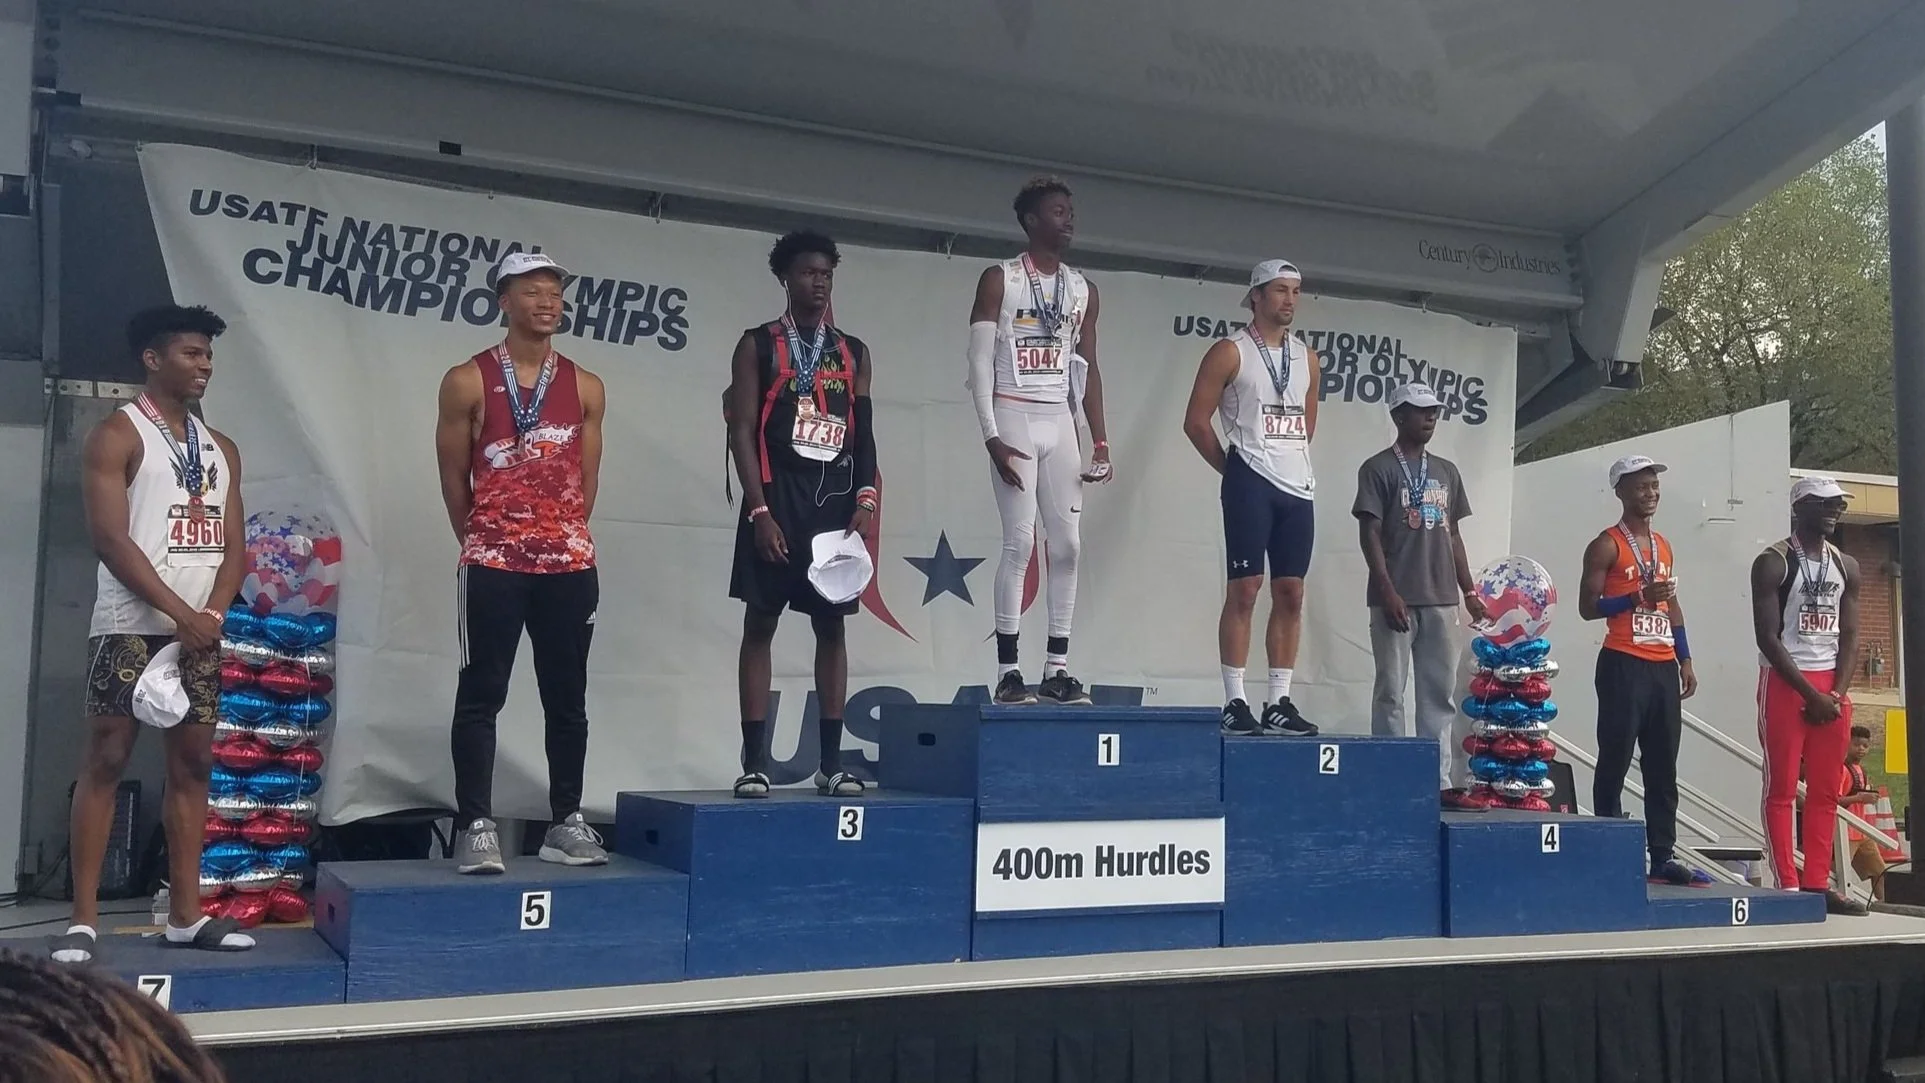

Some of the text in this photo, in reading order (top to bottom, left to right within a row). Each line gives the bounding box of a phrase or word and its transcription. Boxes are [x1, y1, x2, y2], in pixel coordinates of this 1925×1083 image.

[189, 189, 542, 264] USATF NATIONA
[1418, 239, 1561, 275] Century Industries
[286, 231, 688, 317] JUNIOR MPIC
[243, 248, 690, 352] CHAMPIOHIPS
[1173, 316, 1407, 359] USAT ATIONAL
[1017, 348, 1061, 369] 5047
[538, 432, 564, 442] BLAZE
[795, 419, 844, 447] 1738
[1264, 415, 1304, 435] 8724
[170, 519, 223, 546] 4960
[1633, 615, 1669, 636] 5387
[1801, 613, 1836, 632] 5907
[1102, 736, 1113, 764] 1
[1321, 746, 1336, 772] 2
[841, 809, 858, 837] 3
[1543, 825, 1557, 851] 4
[993, 844, 1211, 881] 400m Hurdles
[525, 895, 545, 926] 5
[1735, 900, 1747, 923] 6
[142, 978, 166, 1000] 7
